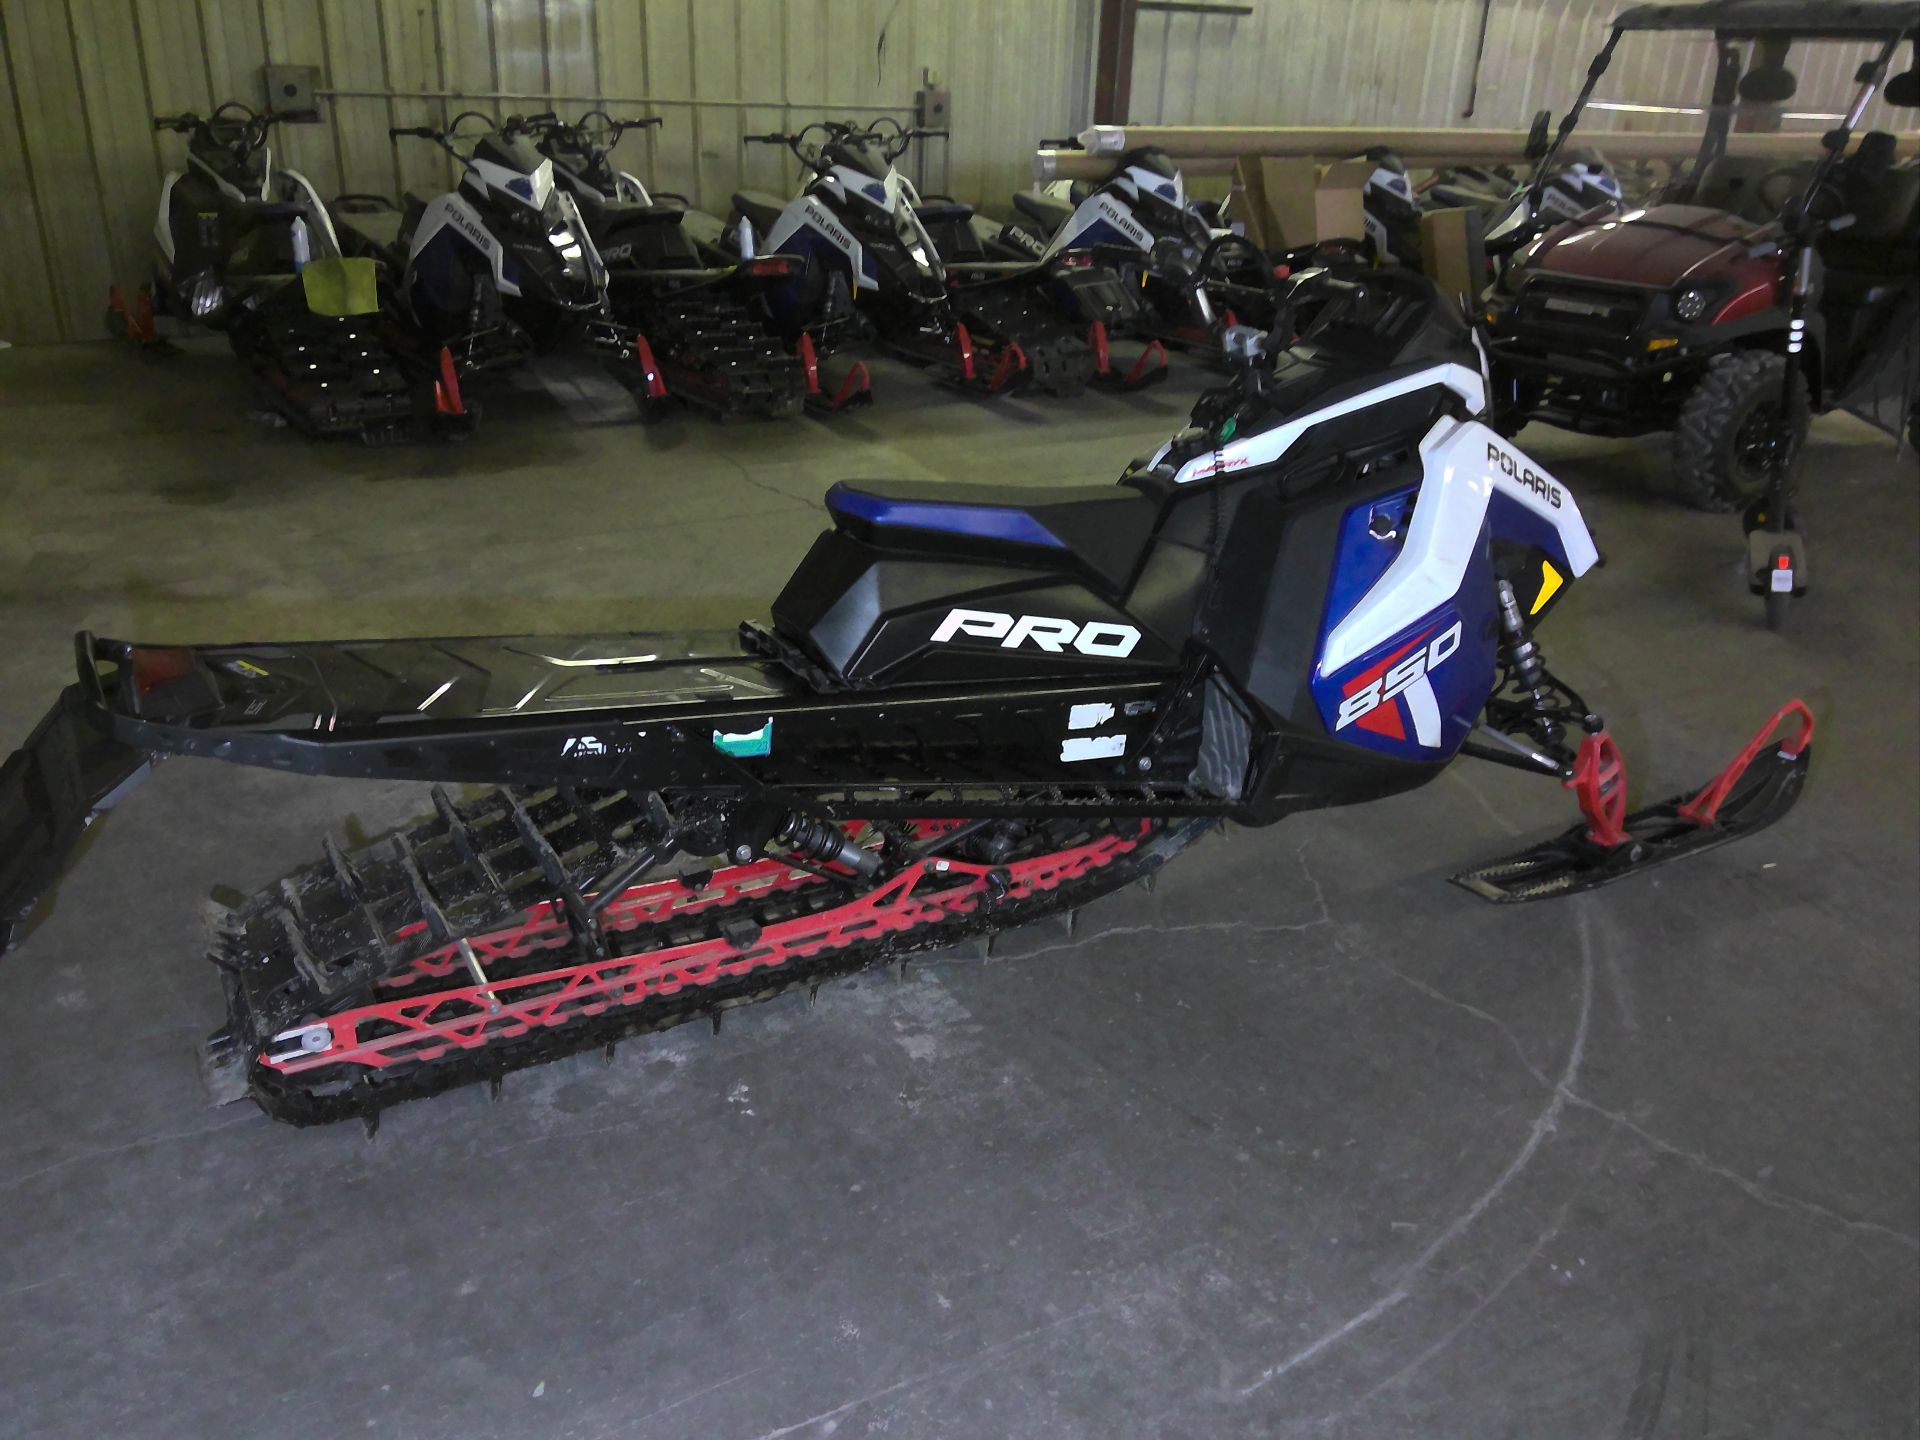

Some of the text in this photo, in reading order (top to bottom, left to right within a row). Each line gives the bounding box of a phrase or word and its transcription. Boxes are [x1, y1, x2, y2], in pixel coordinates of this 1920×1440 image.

[445, 202, 491, 250] POLARIS
[805, 205, 852, 250] POLARIS
[1010, 225, 1046, 257] PRO
[1099, 201, 1144, 243] POLARIS
[1487, 442, 1562, 509] POLARIS
[930, 608, 1142, 658] PRO
[1336, 620, 1462, 732] 850
